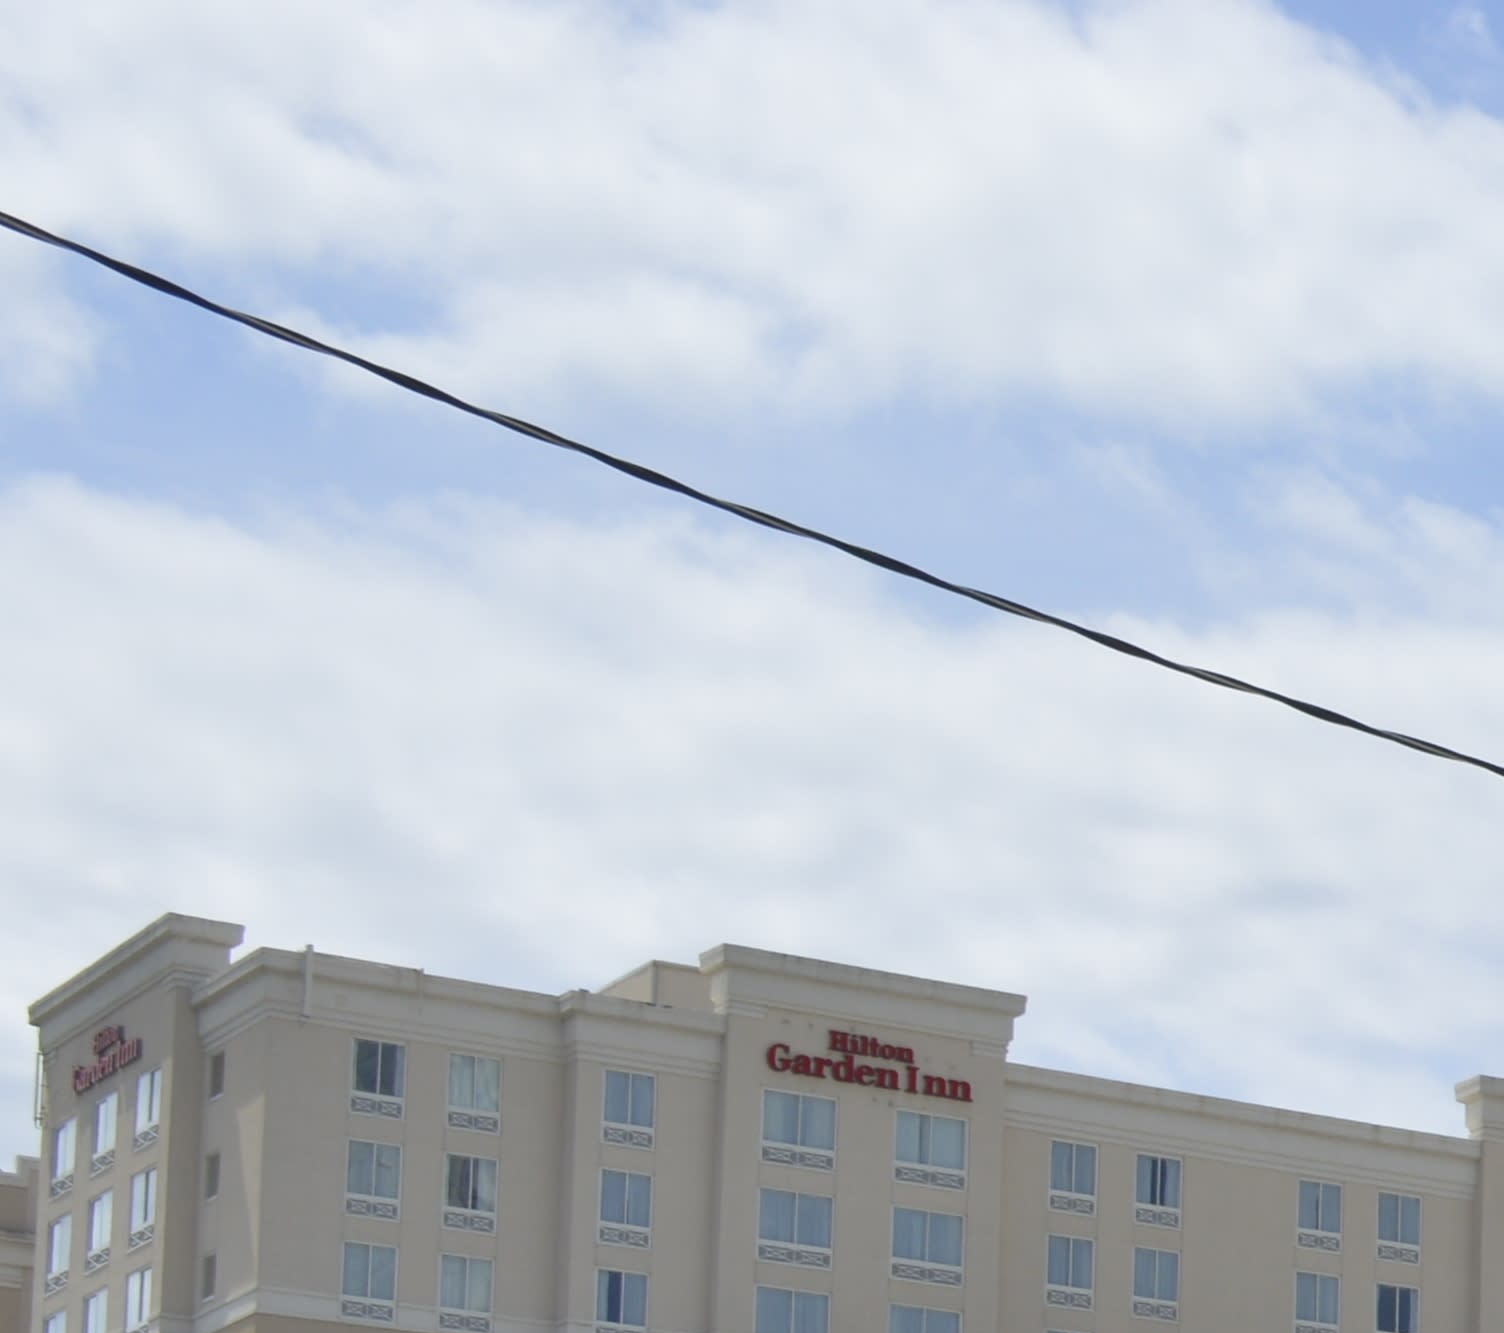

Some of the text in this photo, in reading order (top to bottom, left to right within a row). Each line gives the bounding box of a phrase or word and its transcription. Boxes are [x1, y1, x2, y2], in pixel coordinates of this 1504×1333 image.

[828, 1029, 915, 1064] Hilton
[766, 1043, 975, 1103] Garden Inn
